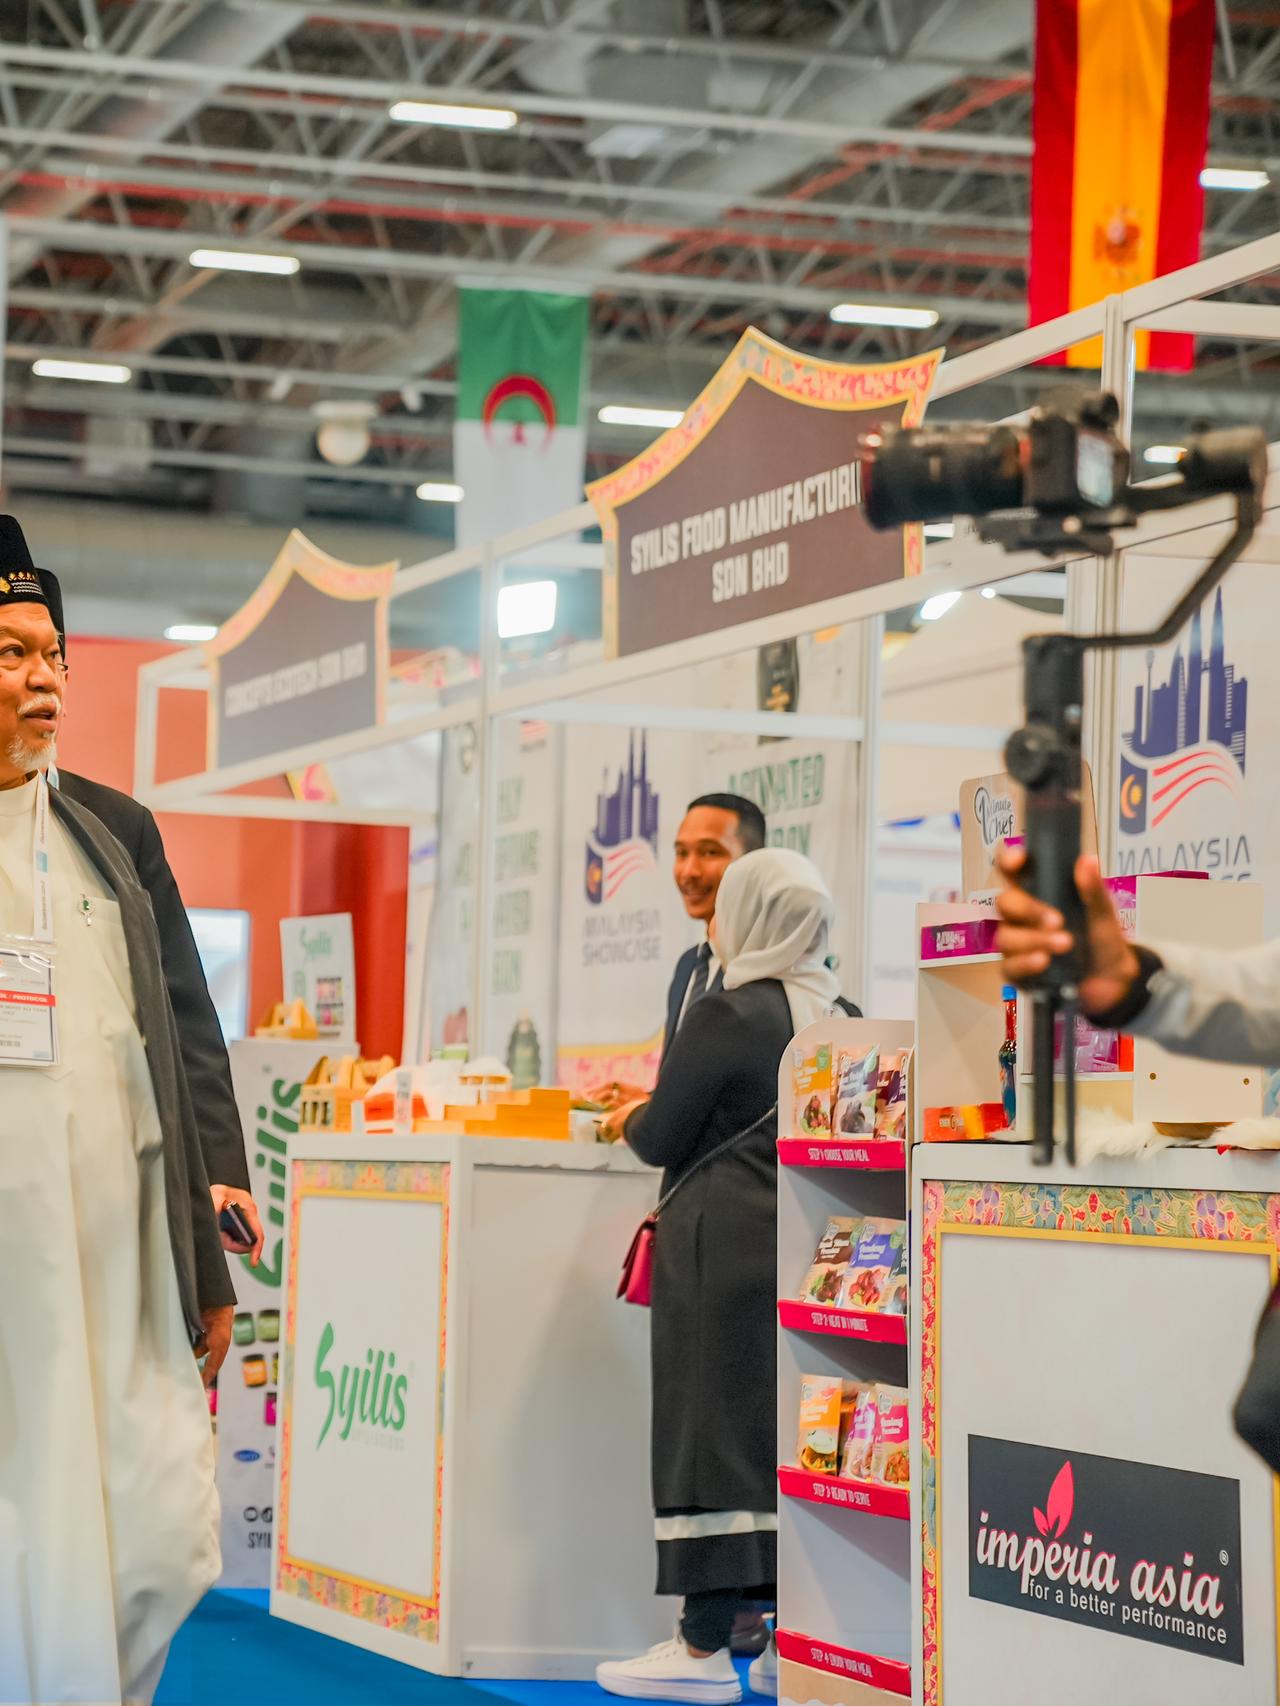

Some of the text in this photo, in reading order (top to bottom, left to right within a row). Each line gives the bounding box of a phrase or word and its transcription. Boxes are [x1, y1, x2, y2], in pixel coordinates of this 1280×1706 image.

[631, 521, 681, 576] SYILIS
[682, 506, 726, 560] FOOD
[1118, 834, 1251, 875] MALAYSIA
[315, 1321, 408, 1451] Syilis
[976, 1510, 1224, 1619] imperia asia
[1028, 1577, 1227, 1645] for a better performance
